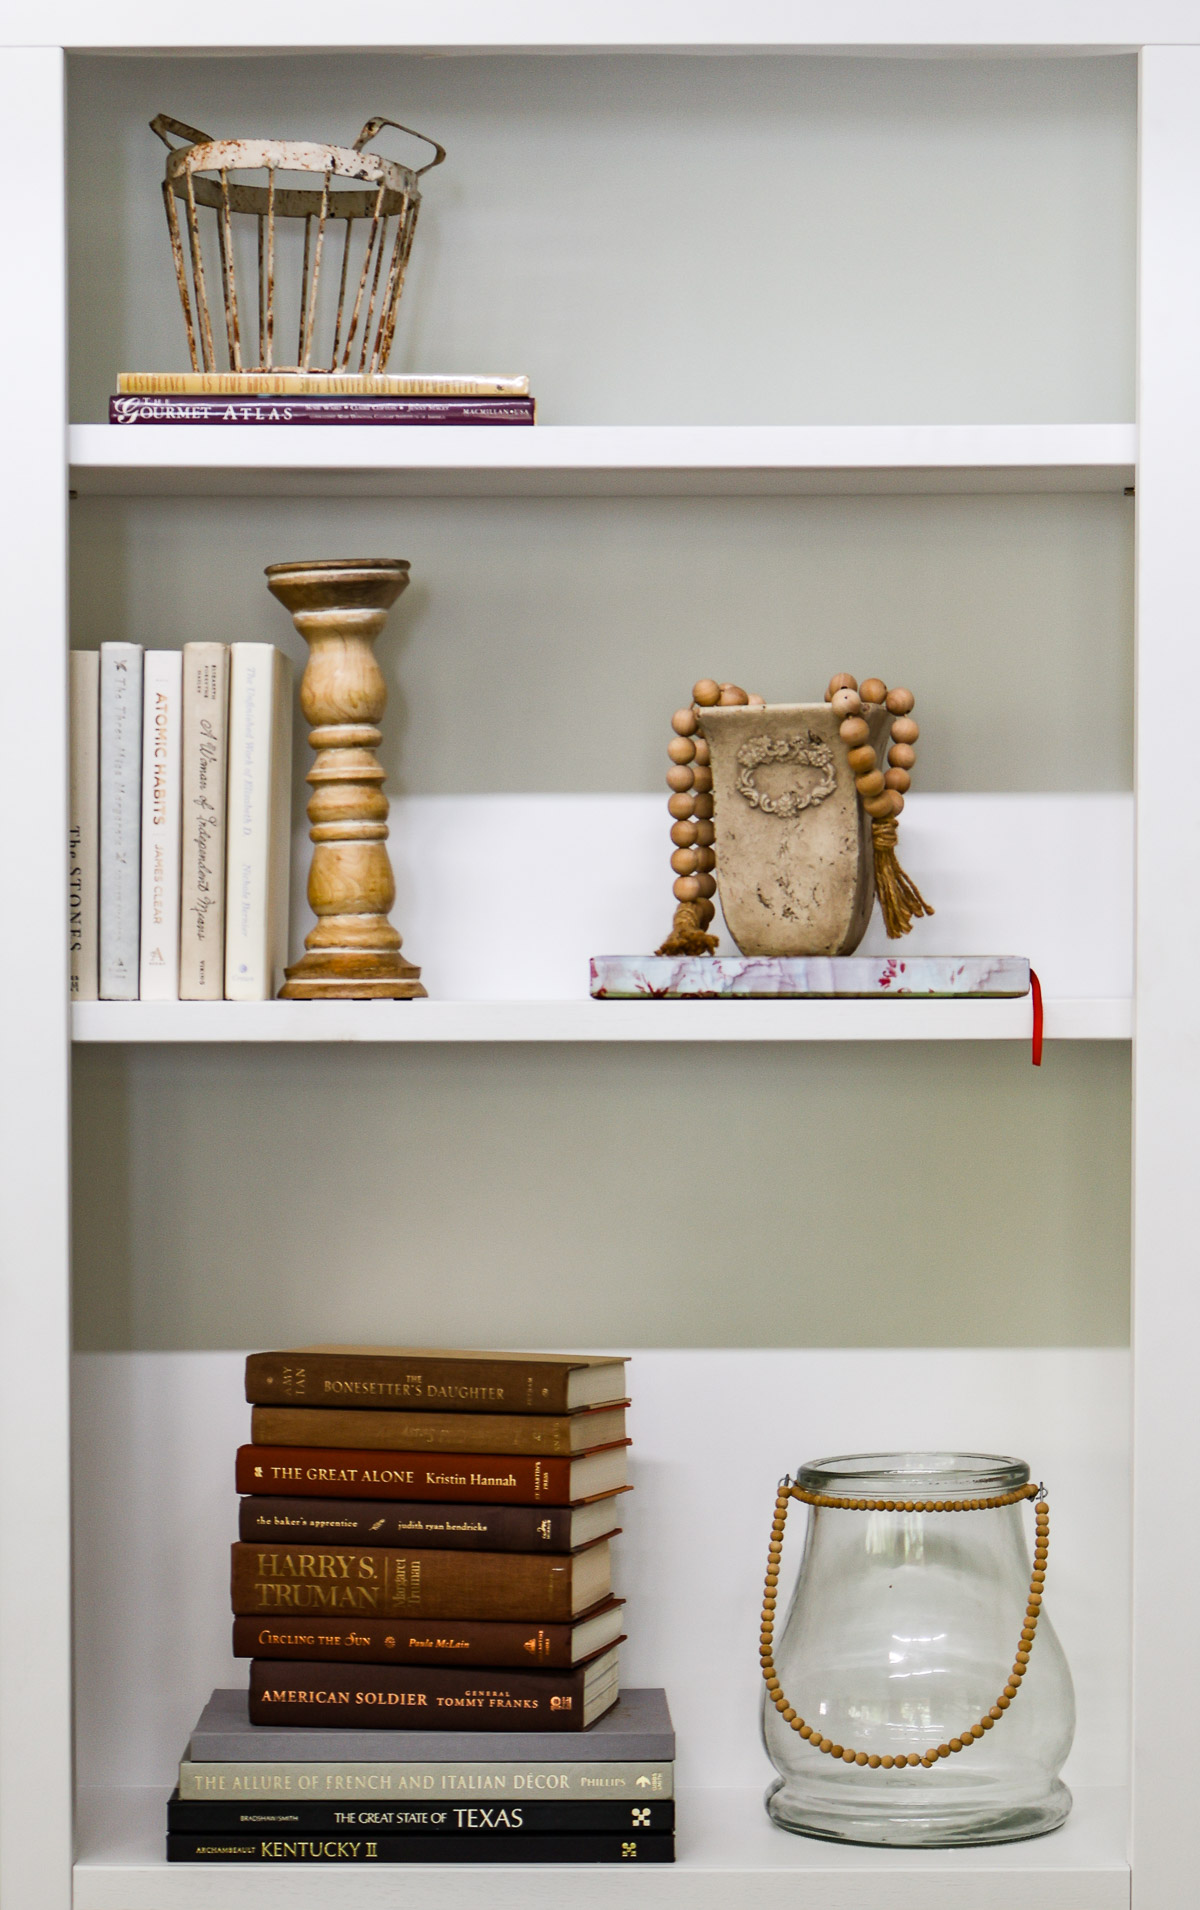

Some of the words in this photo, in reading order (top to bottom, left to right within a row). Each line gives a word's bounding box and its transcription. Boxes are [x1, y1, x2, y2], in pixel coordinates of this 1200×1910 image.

[113, 397, 212, 424] GOURMET
[222, 405, 294, 421] ATLAS
[245, 667, 256, 685] The
[153, 692, 168, 758] ATOMIC
[199, 719, 216, 740] A
[242, 741, 255, 766] Work
[198, 742, 217, 790] Woman
[241, 767, 254, 777] of
[153, 764, 167, 826] HABITS
[192, 794, 214, 811] of
[241, 779, 254, 825] Elizabeth
[69, 826, 81, 859] The
[152, 843, 163, 882] JAMES
[196, 815, 217, 893] Independent
[152, 886, 163, 924] CLEAR
[190, 895, 217, 941] Means
[282, 1366, 293, 1396] AMY
[295, 1368, 306, 1396] TAN
[406, 1375, 422, 1384] THE
[323, 1380, 423, 1398] BONESETTER'S
[427, 1384, 504, 1400] DAUGHTER
[271, 1467, 302, 1480] THE
[306, 1467, 357, 1482] GREAT
[361, 1469, 414, 1484] ALONE
[426, 1471, 466, 1486] Kristin
[470, 1473, 517, 1487] Hannah
[256, 1515, 271, 1525] the
[273, 1516, 307, 1526] baker's
[309, 1518, 358, 1528] apprentice
[397, 1520, 423, 1531] judith
[425, 1523, 444, 1532] ryan
[446, 1522, 488, 1532] hendricks
[257, 1554, 354, 1579] HARRY
[357, 1556, 378, 1580] S.
[410, 1560, 421, 1607] Truman
[254, 1584, 380, 1609] TRUMAN
[258, 1630, 314, 1646] CIRCLING
[318, 1636, 341, 1646] THE
[344, 1631, 371, 1647] SUN
[409, 1638, 432, 1648] Paula
[435, 1639, 470, 1649] McLain
[261, 1689, 350, 1704] AMERICAN
[355, 1691, 428, 1706] SOLDIER
[436, 1697, 485, 1709] TOMMY
[489, 1698, 539, 1709] FRANKS
[195, 1774, 227, 1790] THE
[232, 1774, 294, 1790] ALLURE
[298, 1774, 321, 1790] OF
[326, 1774, 391, 1790] FRENCH
[398, 1774, 434, 1790] AND
[442, 1774, 508, 1789] ITALIAN
[513, 1771, 570, 1789] DÉCOR
[580, 1777, 626, 1787] PHILLIPS
[334, 1812, 356, 1824] THE
[357, 1812, 394, 1824] GREAT
[396, 1812, 427, 1824] STATE
[430, 1812, 447, 1824] OF
[453, 1808, 523, 1828] TEXAS
[261, 1841, 361, 1858] KENTUCKY
[365, 1842, 378, 1858] II
